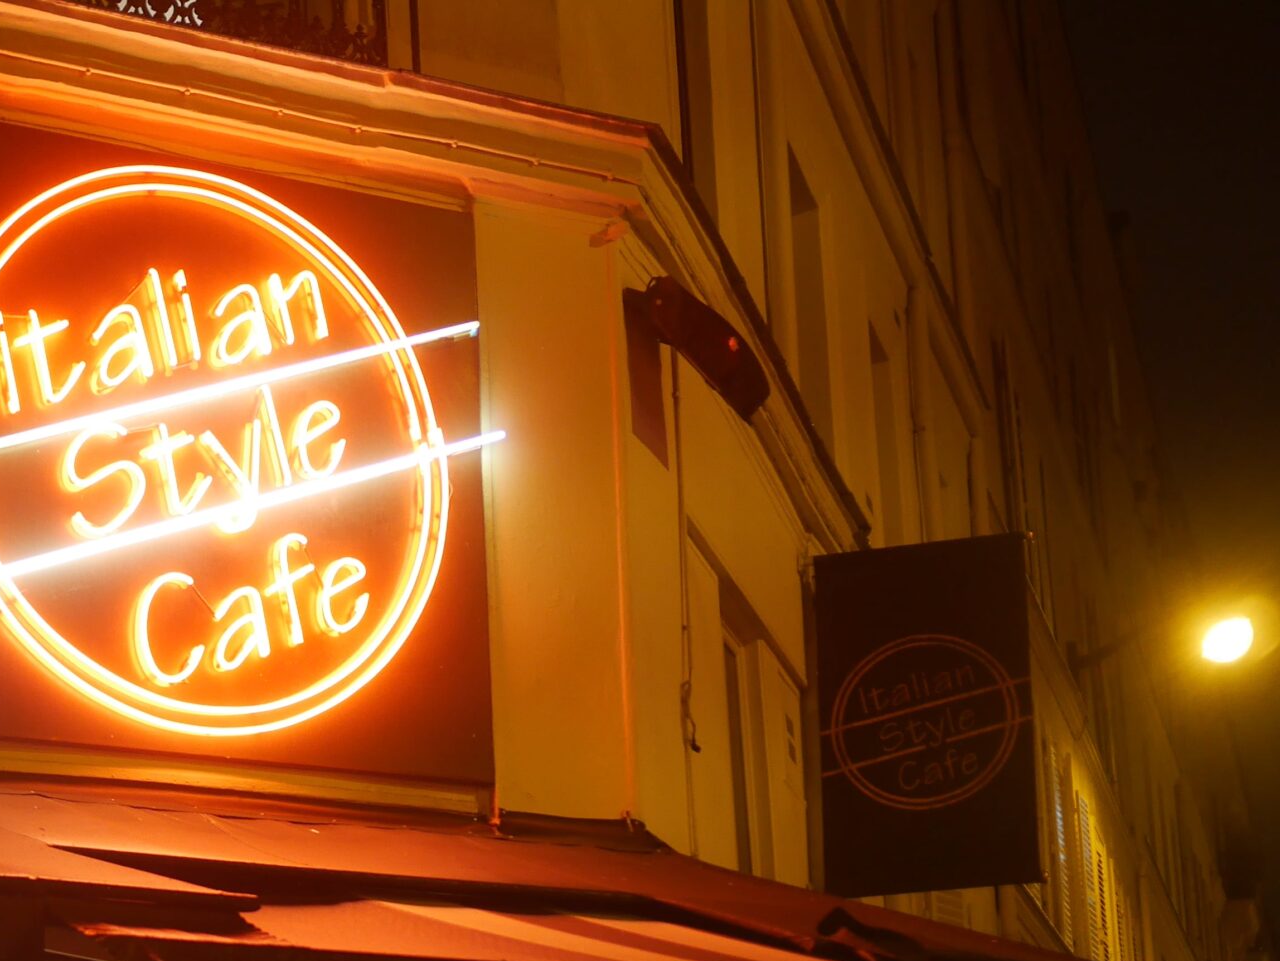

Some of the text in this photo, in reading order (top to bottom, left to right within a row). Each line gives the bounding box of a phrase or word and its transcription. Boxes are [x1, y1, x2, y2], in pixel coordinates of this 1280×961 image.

[59, 384, 348, 538] Style
[130, 533, 370, 687] Cafe
[858, 663, 976, 714] Italian
[878, 706, 976, 754] Style
[897, 747, 980, 791] Cafe
